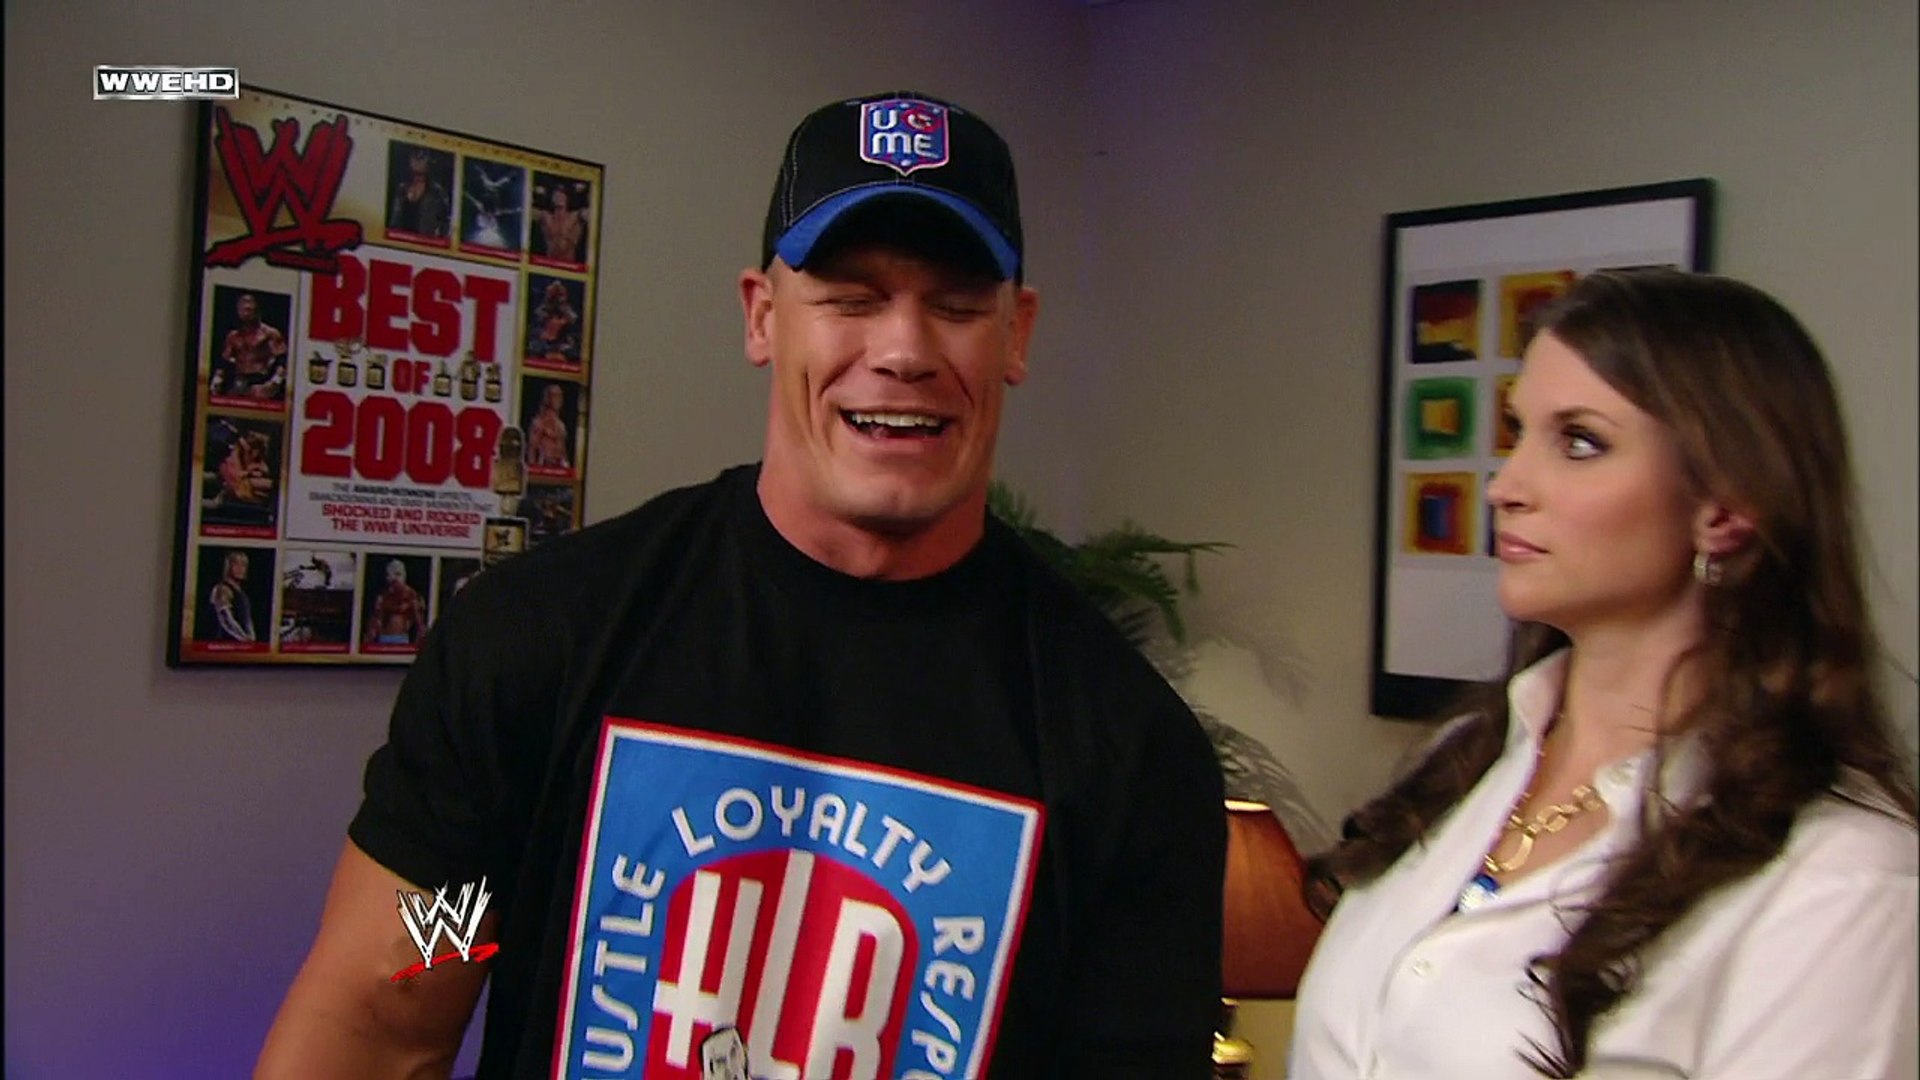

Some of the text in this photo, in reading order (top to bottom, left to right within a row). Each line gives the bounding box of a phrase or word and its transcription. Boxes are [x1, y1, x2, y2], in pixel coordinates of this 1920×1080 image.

[309, 254, 510, 362] BEST
[392, 358, 431, 395] OF
[301, 389, 503, 488] 2008
[322, 503, 481, 525] SHOCKED AND ROCKED
[332, 517, 470, 539] THE WWE UNIVERSE
[673, 786, 952, 893] LOYALTY
[581, 855, 665, 1080] USTLE
[903, 916, 986, 1080] RESP
